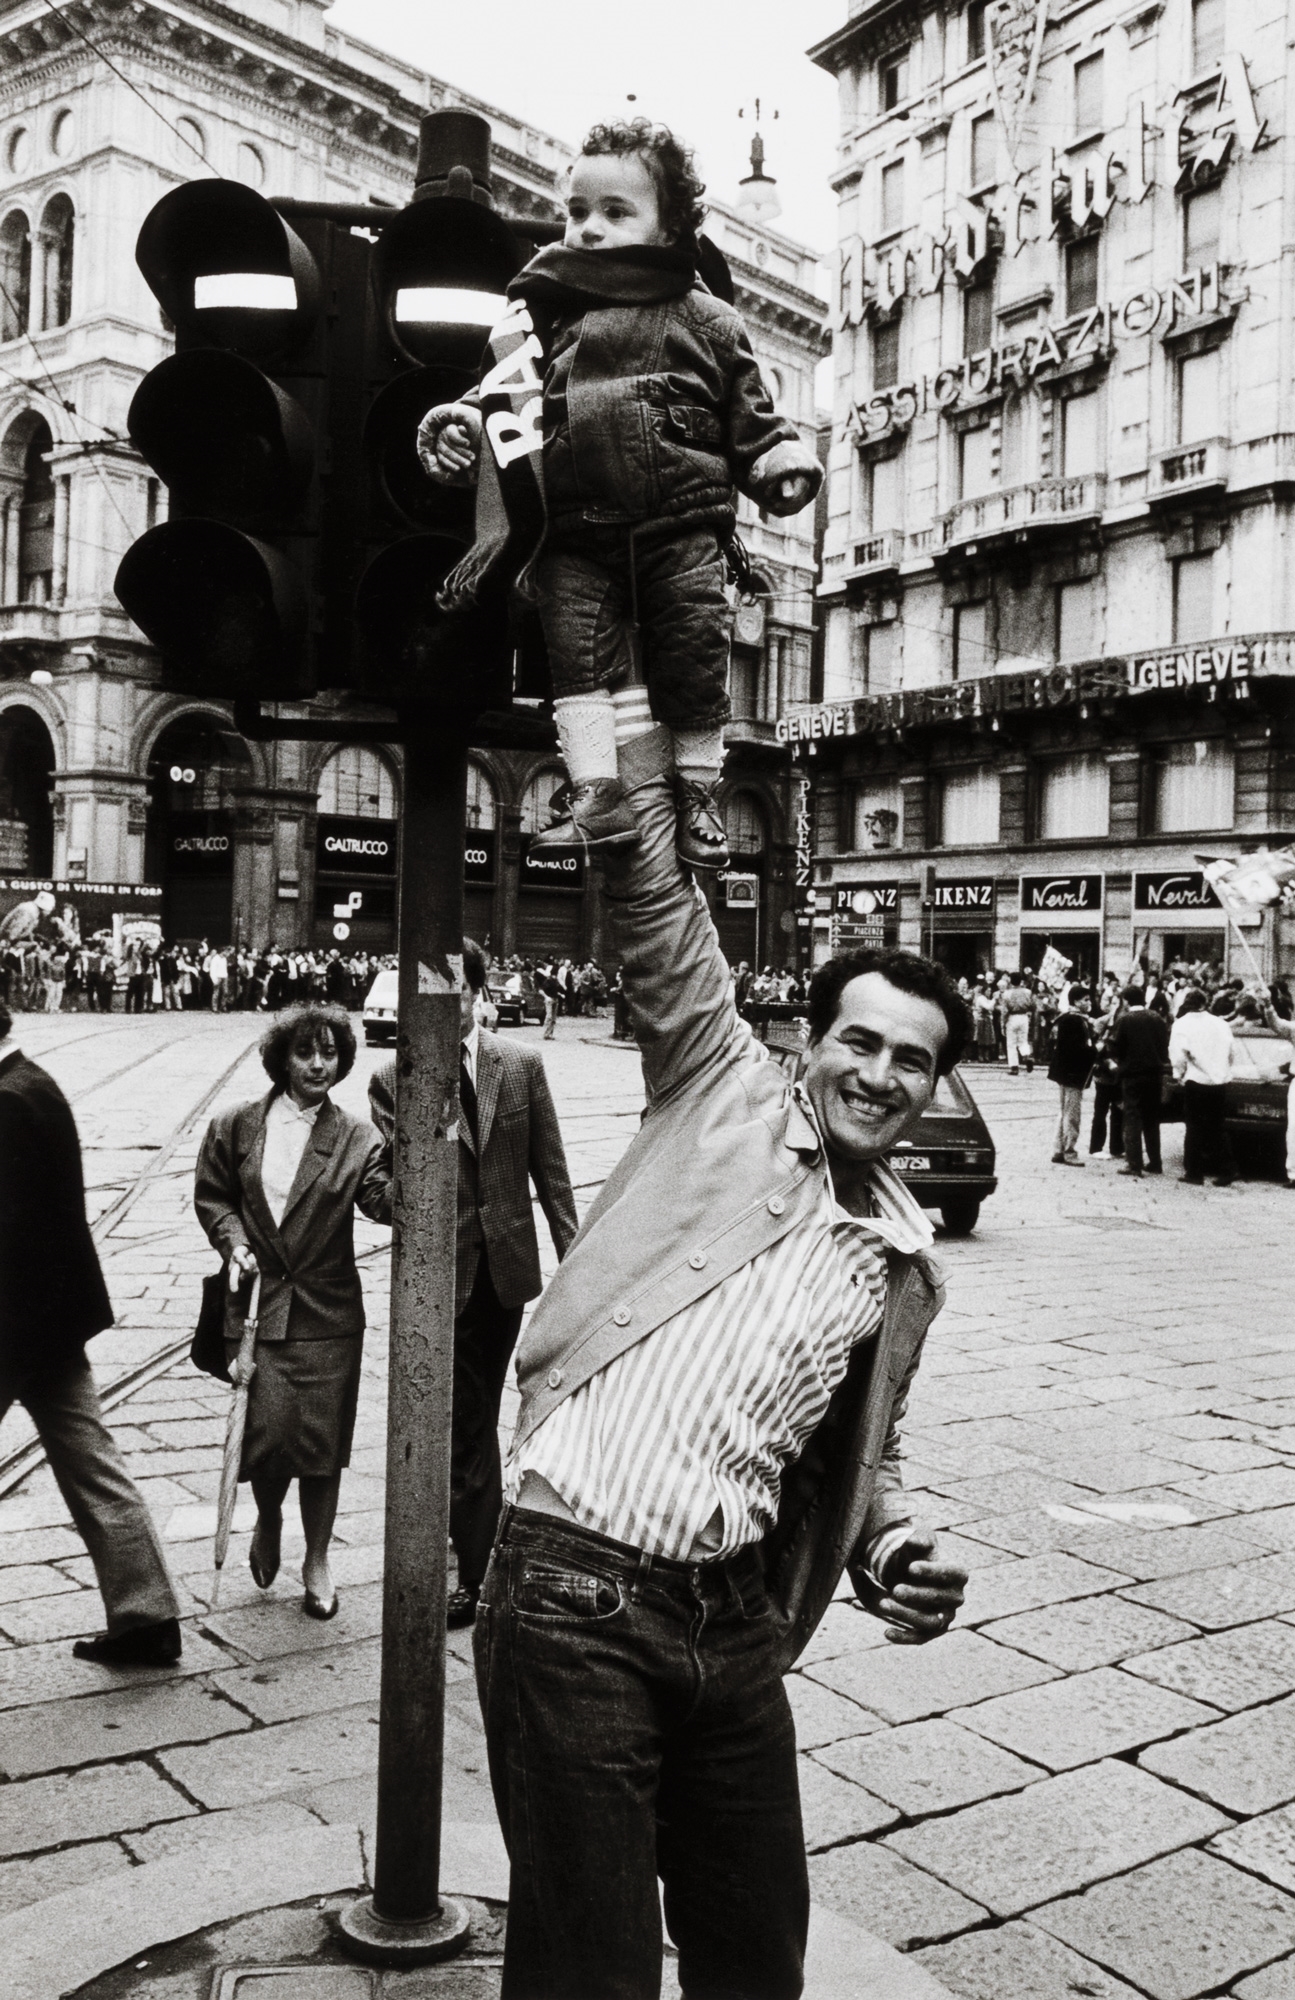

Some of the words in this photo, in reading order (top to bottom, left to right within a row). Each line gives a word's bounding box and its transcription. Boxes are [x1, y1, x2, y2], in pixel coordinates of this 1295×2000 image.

[841, 262, 1222, 441] ASSICURAZIONI
[775, 711, 846, 742] GENEVE
[1139, 644, 1249, 689] GENEVE
[174, 836, 229, 851] GALTRUCCO
[795, 779, 811, 887] PIKENZ
[325, 837, 388, 856] GALTRUCCO
[10, 880, 54, 891] GUSTO
[57, 882, 70, 892] DI
[73, 883, 115, 895] VIVERE
[118, 886, 131, 895] IN
[837, 888, 897, 908] PINZ
[925, 885, 992, 907] IKENZ
